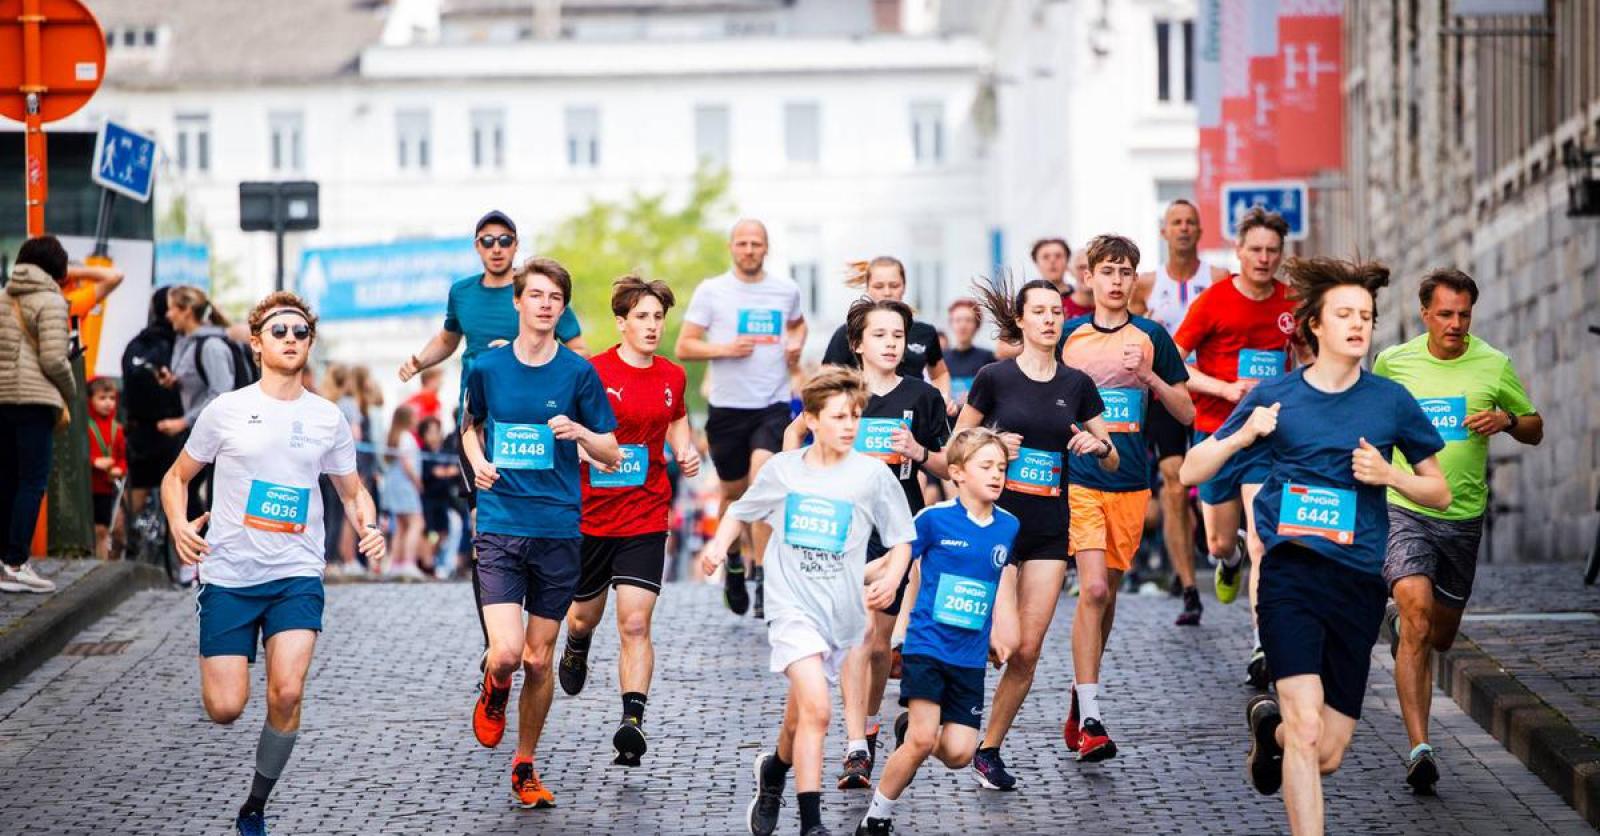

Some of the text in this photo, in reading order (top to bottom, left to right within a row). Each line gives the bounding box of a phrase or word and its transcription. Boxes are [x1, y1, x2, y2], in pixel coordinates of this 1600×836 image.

[1249, 365, 1277, 376] 6526
[1105, 406, 1129, 418] 314
[500, 442, 545, 456] 21448
[865, 436, 892, 449] 656
[1020, 466, 1053, 482] 6613
[260, 502, 297, 518] 6036
[1296, 507, 1340, 525] 6442
[790, 514, 838, 536] 20531
[943, 595, 988, 616] 20612
